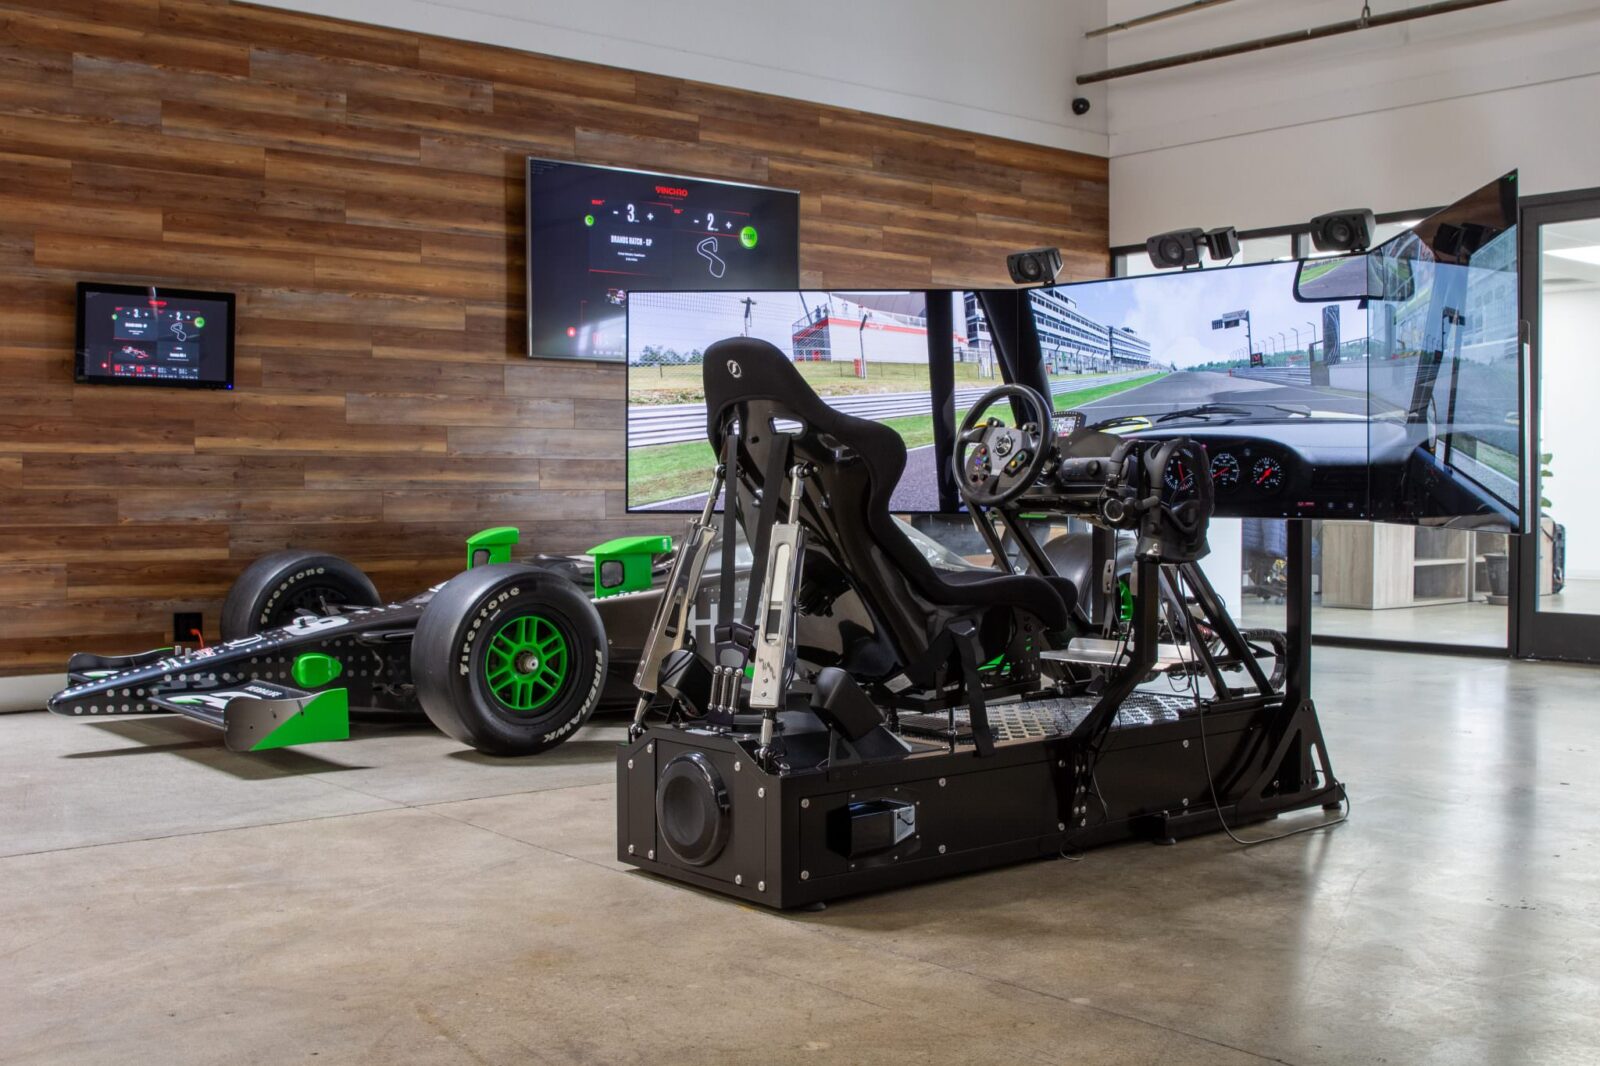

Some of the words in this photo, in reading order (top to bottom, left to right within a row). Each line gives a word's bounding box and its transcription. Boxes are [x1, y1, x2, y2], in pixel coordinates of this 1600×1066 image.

[627, 203, 635, 222] 3
[707, 213, 715, 230] 2
[260, 567, 325, 625] Firestone
[460, 587, 520, 677] Firestone
[542, 649, 603, 744] FIREHAWK
